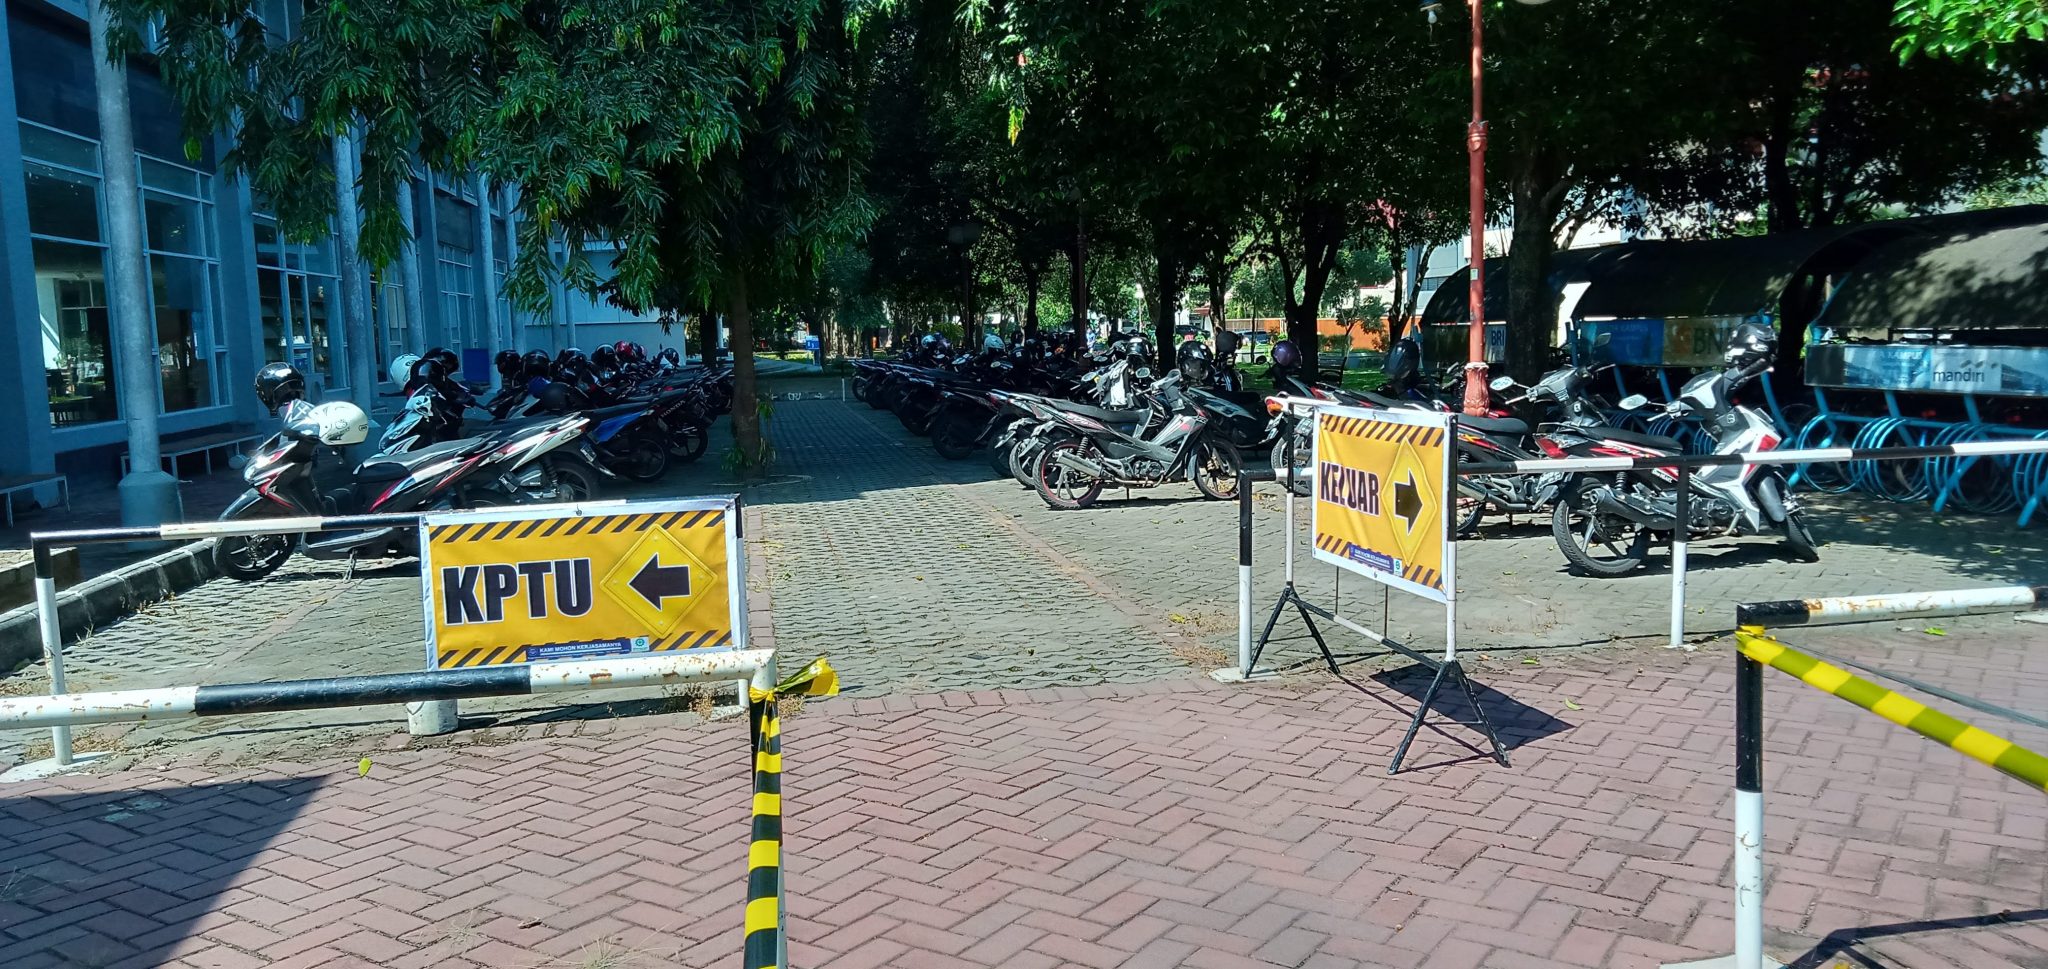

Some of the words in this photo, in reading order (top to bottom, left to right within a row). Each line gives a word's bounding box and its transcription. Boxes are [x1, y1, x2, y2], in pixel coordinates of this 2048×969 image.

[1491, 330, 1504, 346] BRI
[1933, 368, 1985, 382] mandiri
[1320, 460, 1380, 516] KELUAR
[442, 558, 593, 625] KPTU
